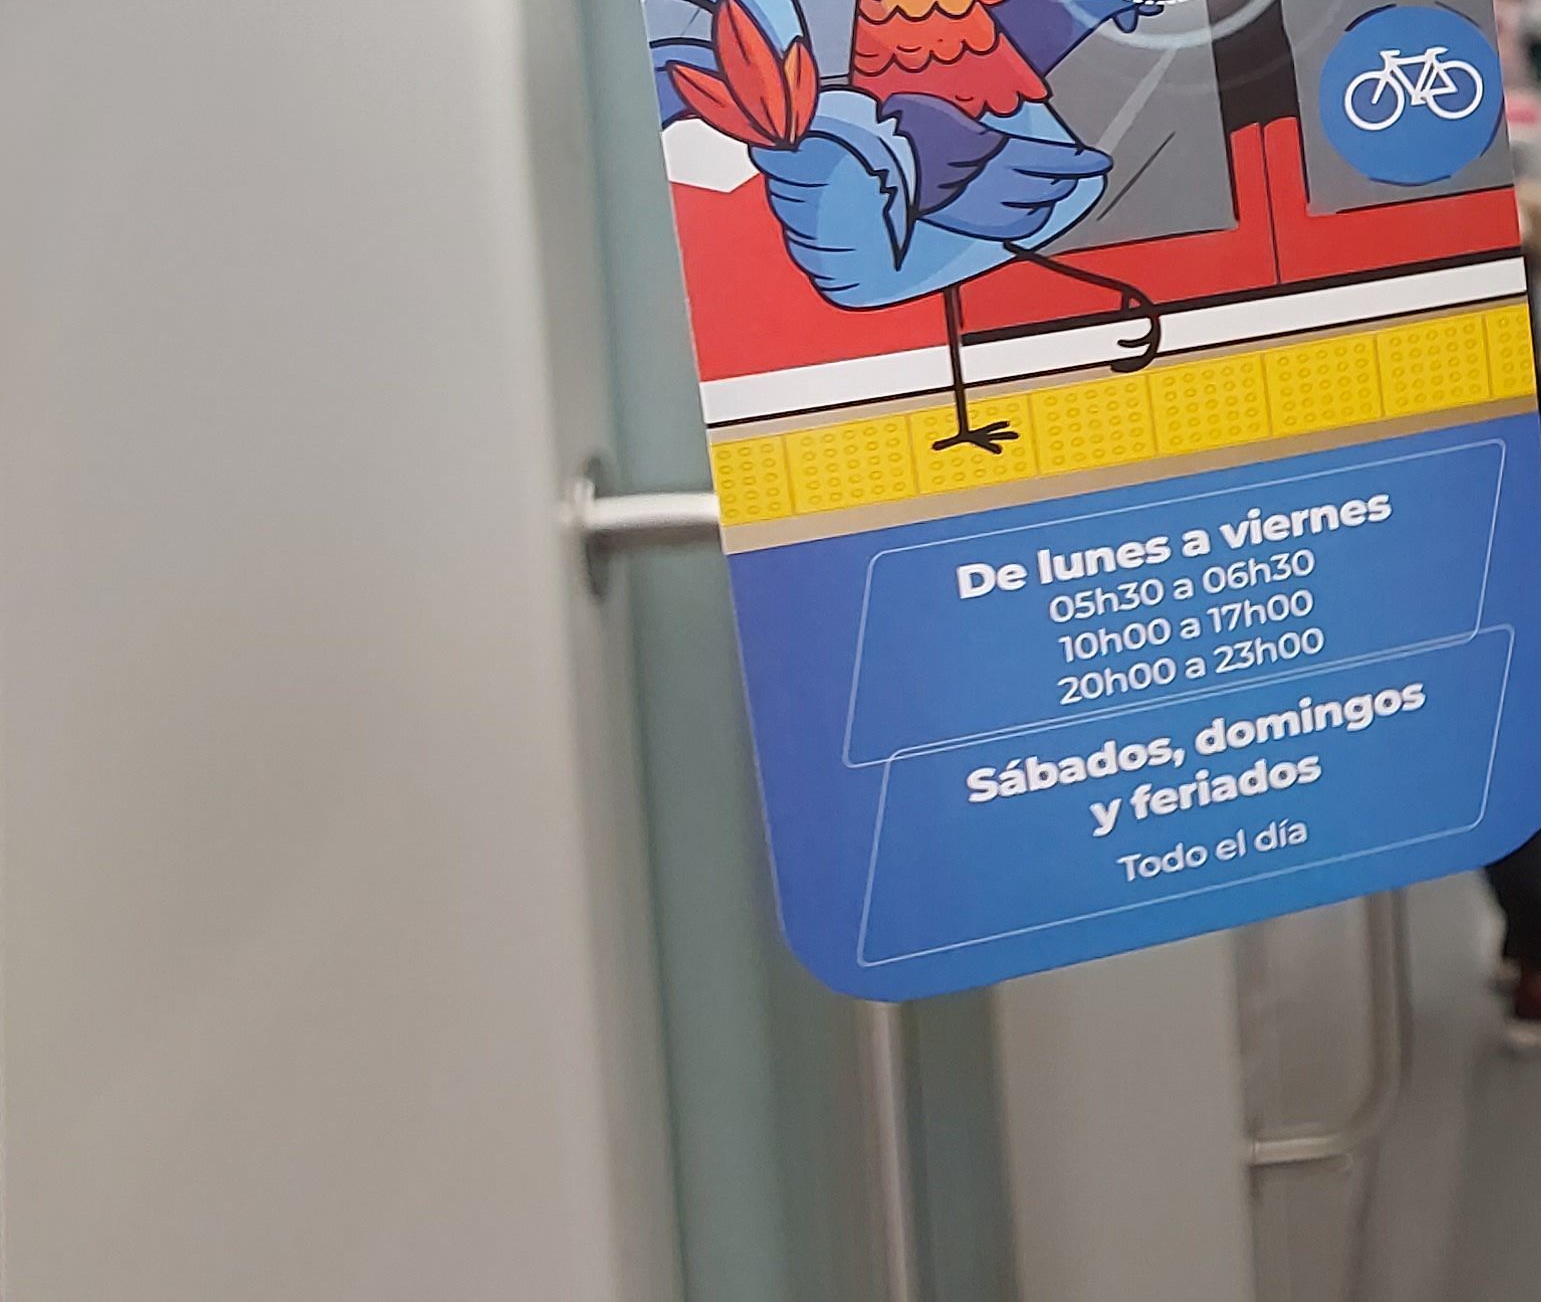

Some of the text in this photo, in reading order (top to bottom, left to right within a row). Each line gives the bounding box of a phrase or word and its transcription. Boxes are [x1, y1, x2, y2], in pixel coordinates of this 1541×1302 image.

[955, 494, 1392, 599] De lunes a viernes
[1048, 549, 1316, 624] 05h30 a 06h30
[1058, 589, 1314, 664] 10h00 a 17h00
[1057, 627, 1324, 705] 20h00 a 23h00
[966, 683, 1426, 804] Sábados, domingos
[1089, 754, 1322, 837] y feriados
[1116, 818, 1307, 882] Todo el día
